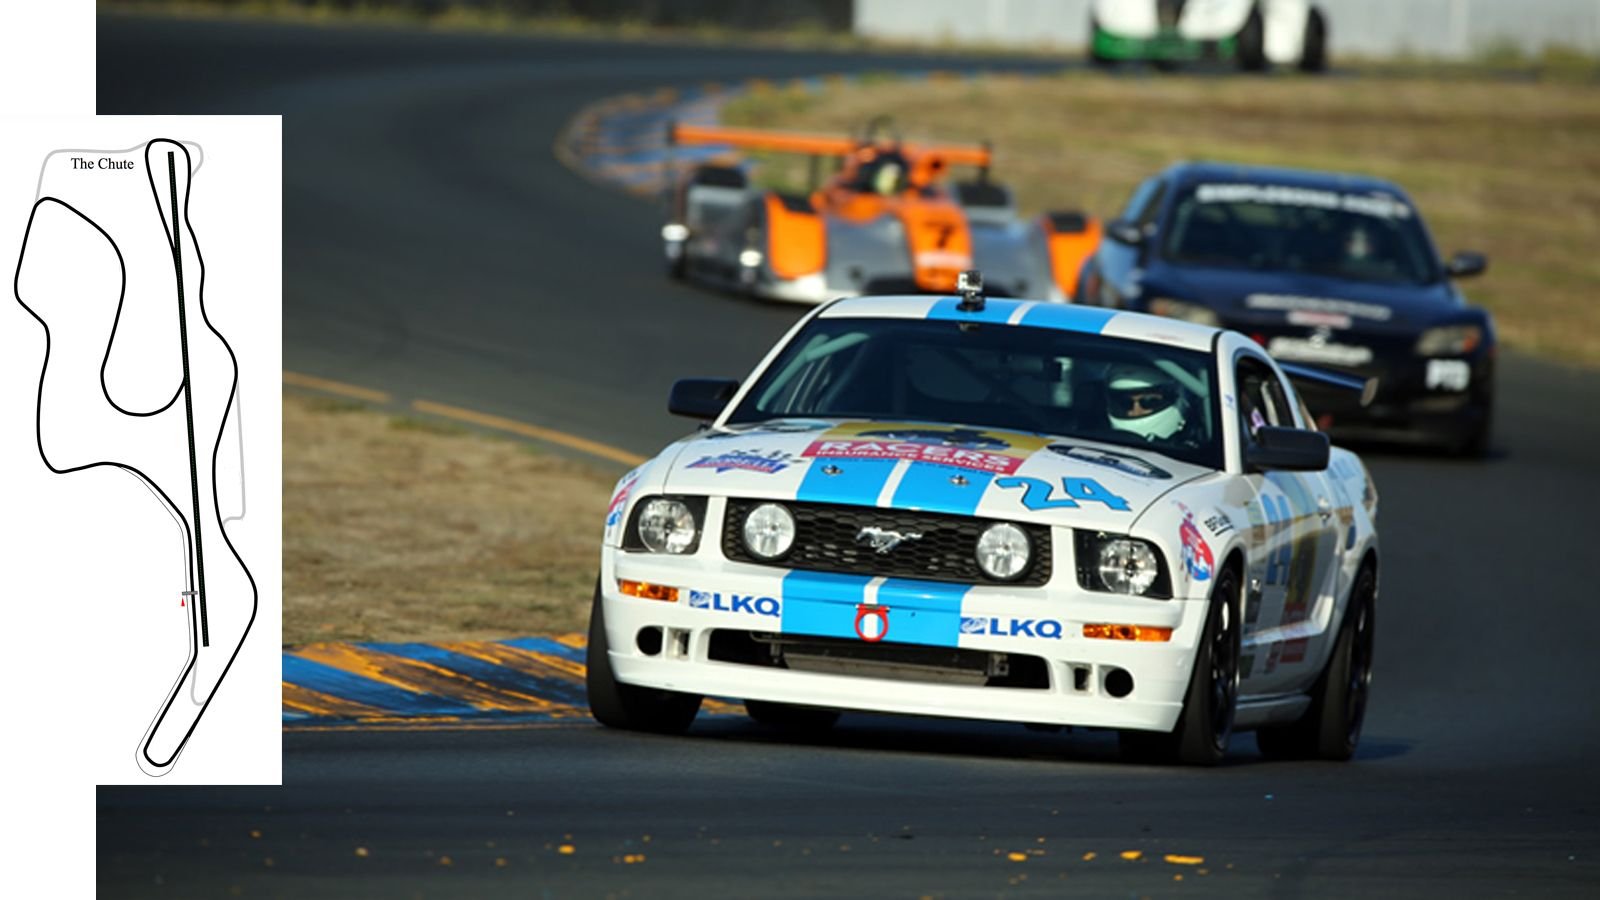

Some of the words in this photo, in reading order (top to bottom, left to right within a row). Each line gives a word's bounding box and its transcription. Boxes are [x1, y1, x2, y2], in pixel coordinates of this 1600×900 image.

[816, 450, 913, 459] INSURANCE
[922, 455, 1006, 472] SERVICES
[817, 441, 1011, 467] RACERS
[995, 476, 1132, 512] 24
[713, 593, 780, 618] LKQ
[989, 618, 1062, 640] LKQ
